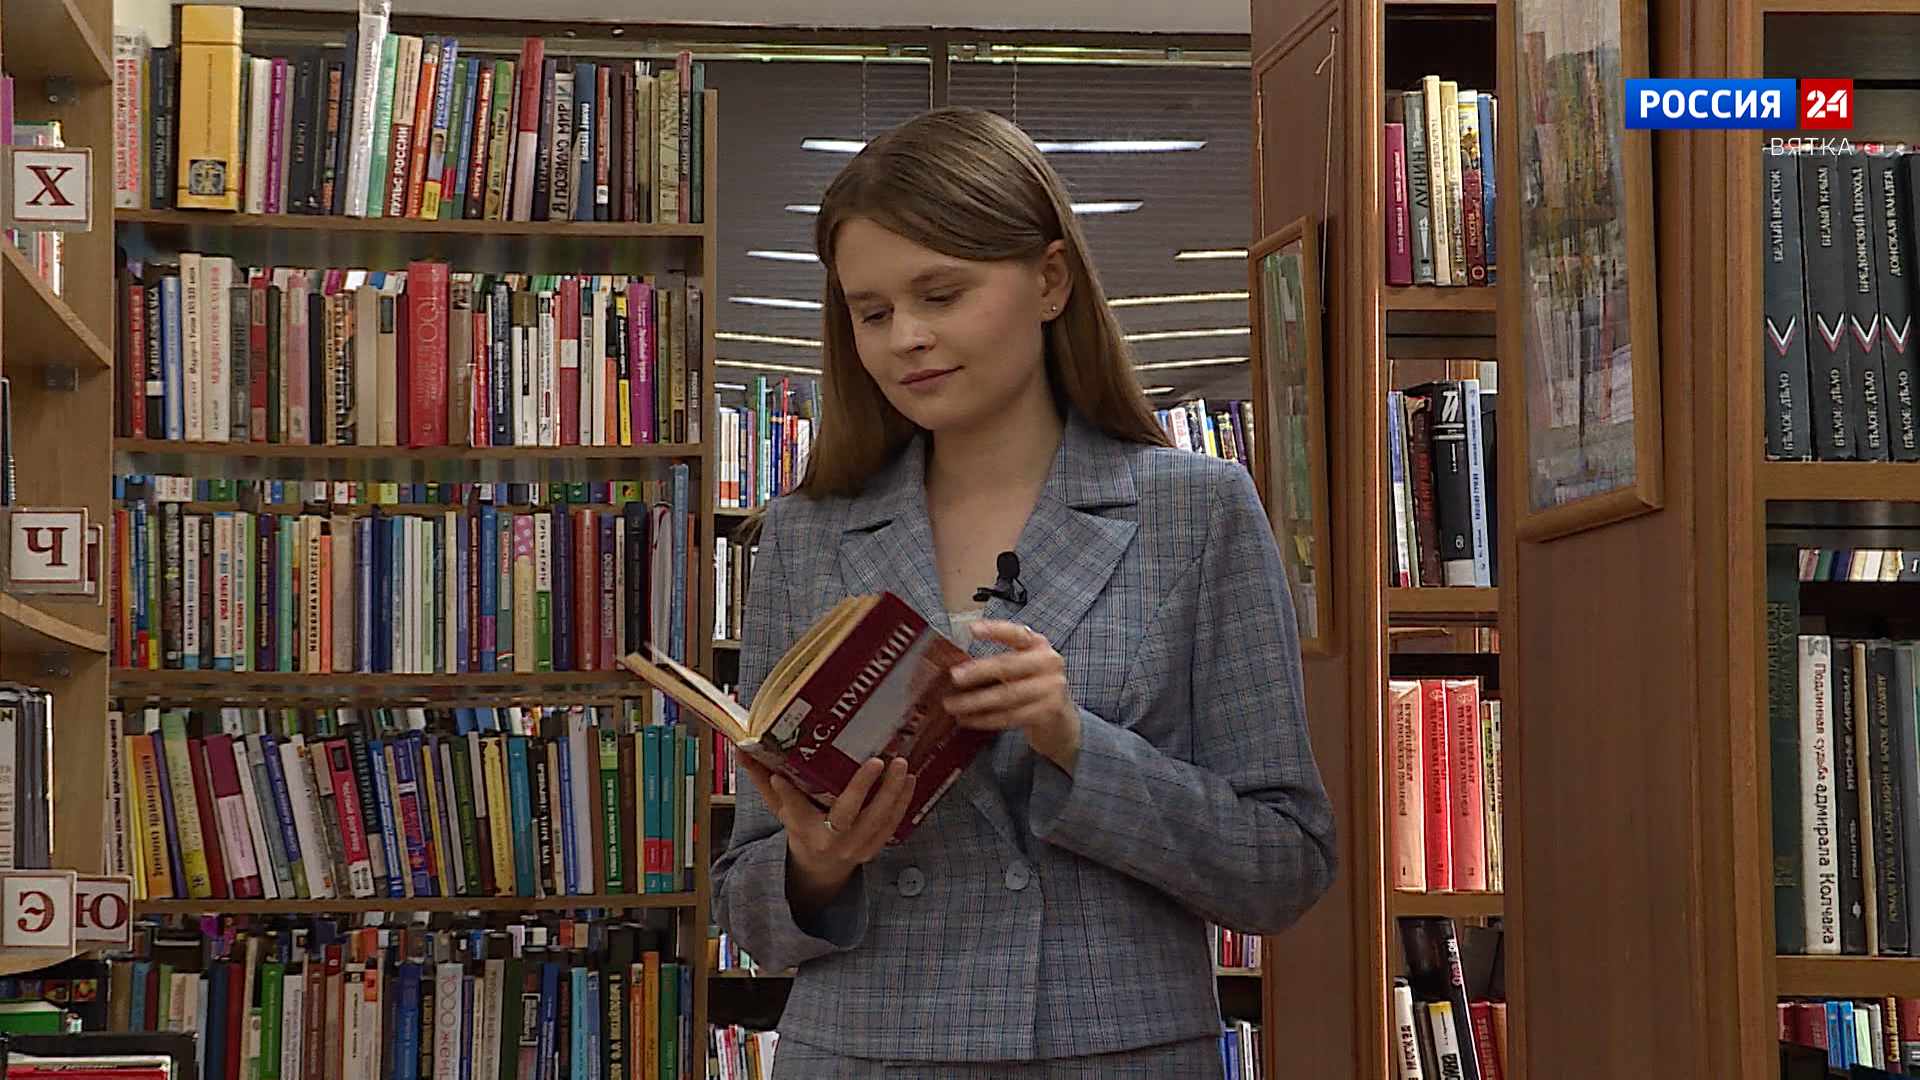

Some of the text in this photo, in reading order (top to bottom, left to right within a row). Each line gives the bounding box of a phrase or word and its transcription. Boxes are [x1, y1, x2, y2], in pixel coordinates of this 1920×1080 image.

[25, 165, 75, 206] Х
[389, 126, 410, 217] ПУЛЬС РОССИИ
[553, 103, 571, 214] Я ПОЗНАЮ МИР
[1412, 151, 1429, 209] ЛУНИН
[1770, 170, 1784, 263] БЕЛЫЙ ВОСТОК
[1817, 167, 1831, 247] БЕЛЫЙ КРЫМ
[1851, 168, 1864, 212] ПОХОД
[1887, 218, 1902, 276] ДОНСКАЯ
[21, 527, 69, 567] Ч
[830, 622, 917, 721] ПУШКИН
[1813, 663, 1836, 945] Подлинная судьба адмирала Колчака
[17, 891, 55, 933] Э
[76, 893, 128, 930] Ю
